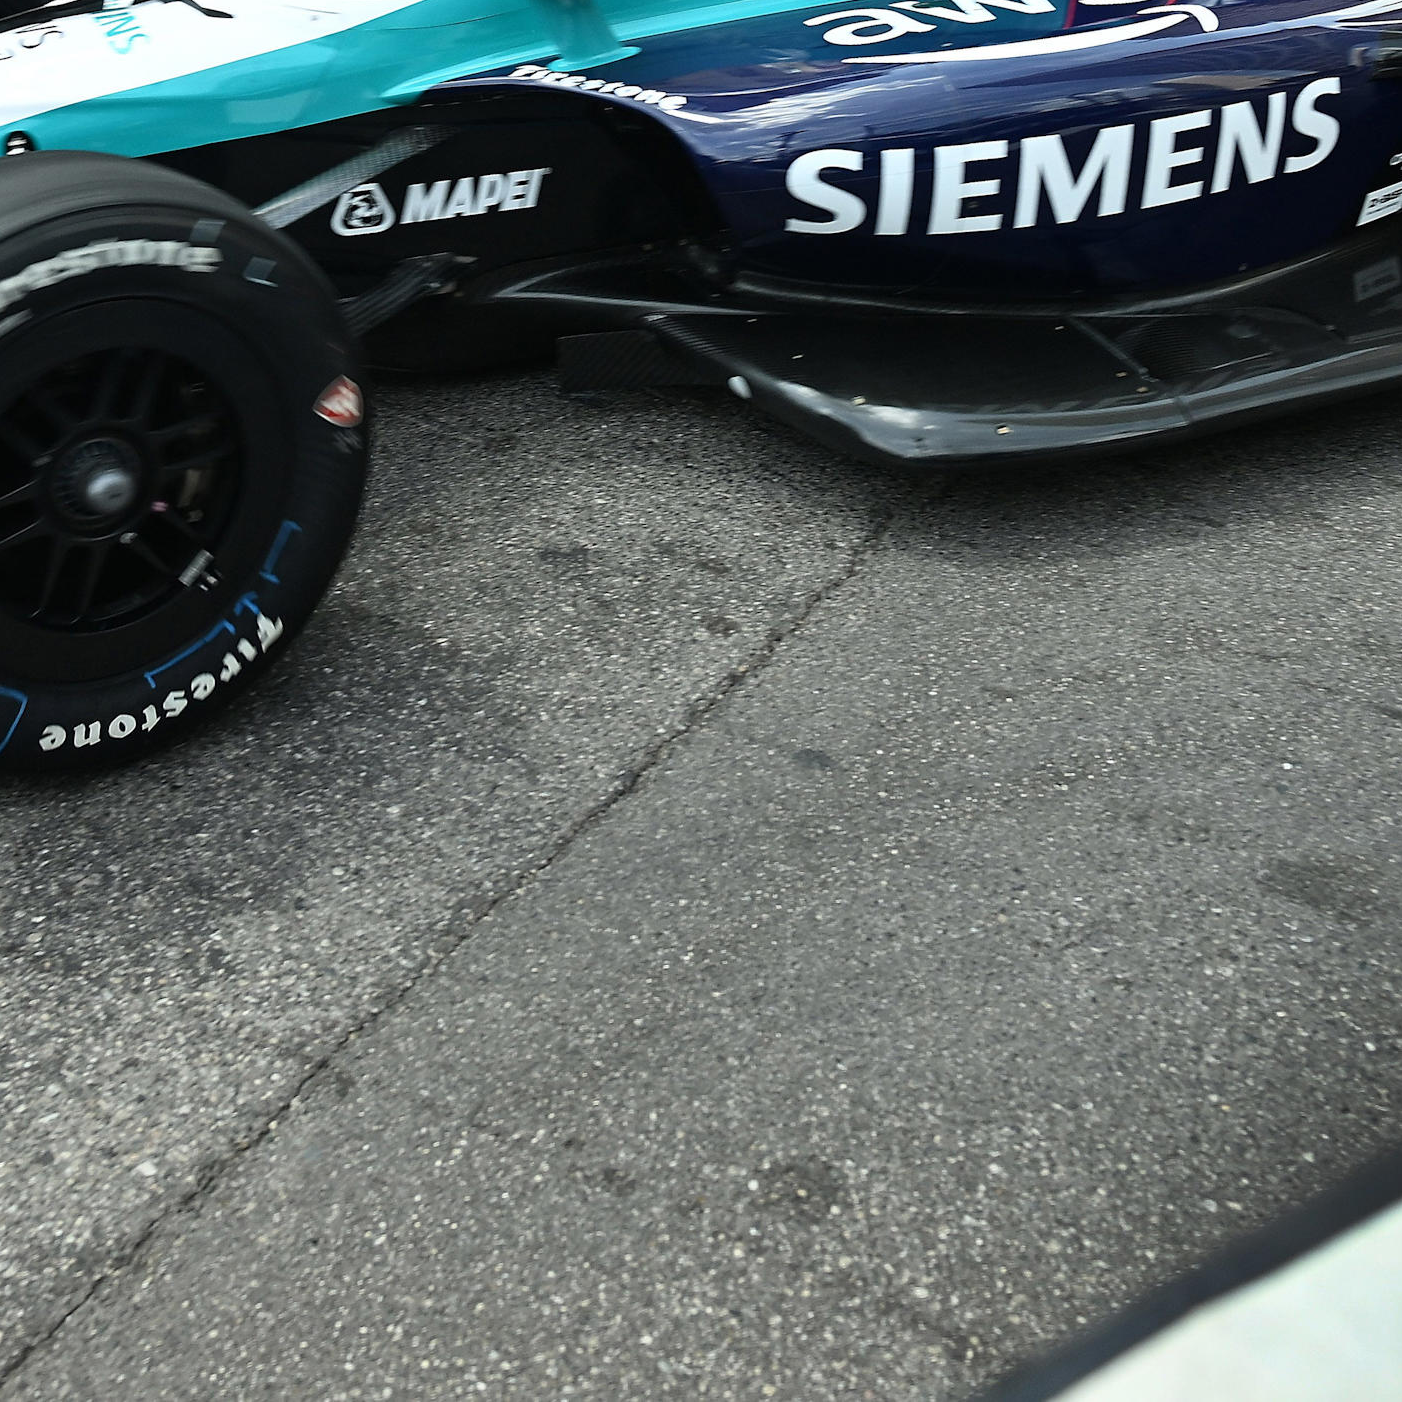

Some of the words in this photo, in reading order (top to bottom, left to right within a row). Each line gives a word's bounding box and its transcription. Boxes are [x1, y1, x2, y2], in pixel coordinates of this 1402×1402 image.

[399, 167, 554, 224] MAPEI
[785, 76, 1342, 237] SIEMENS
[39, 612, 285, 753] Firestone
